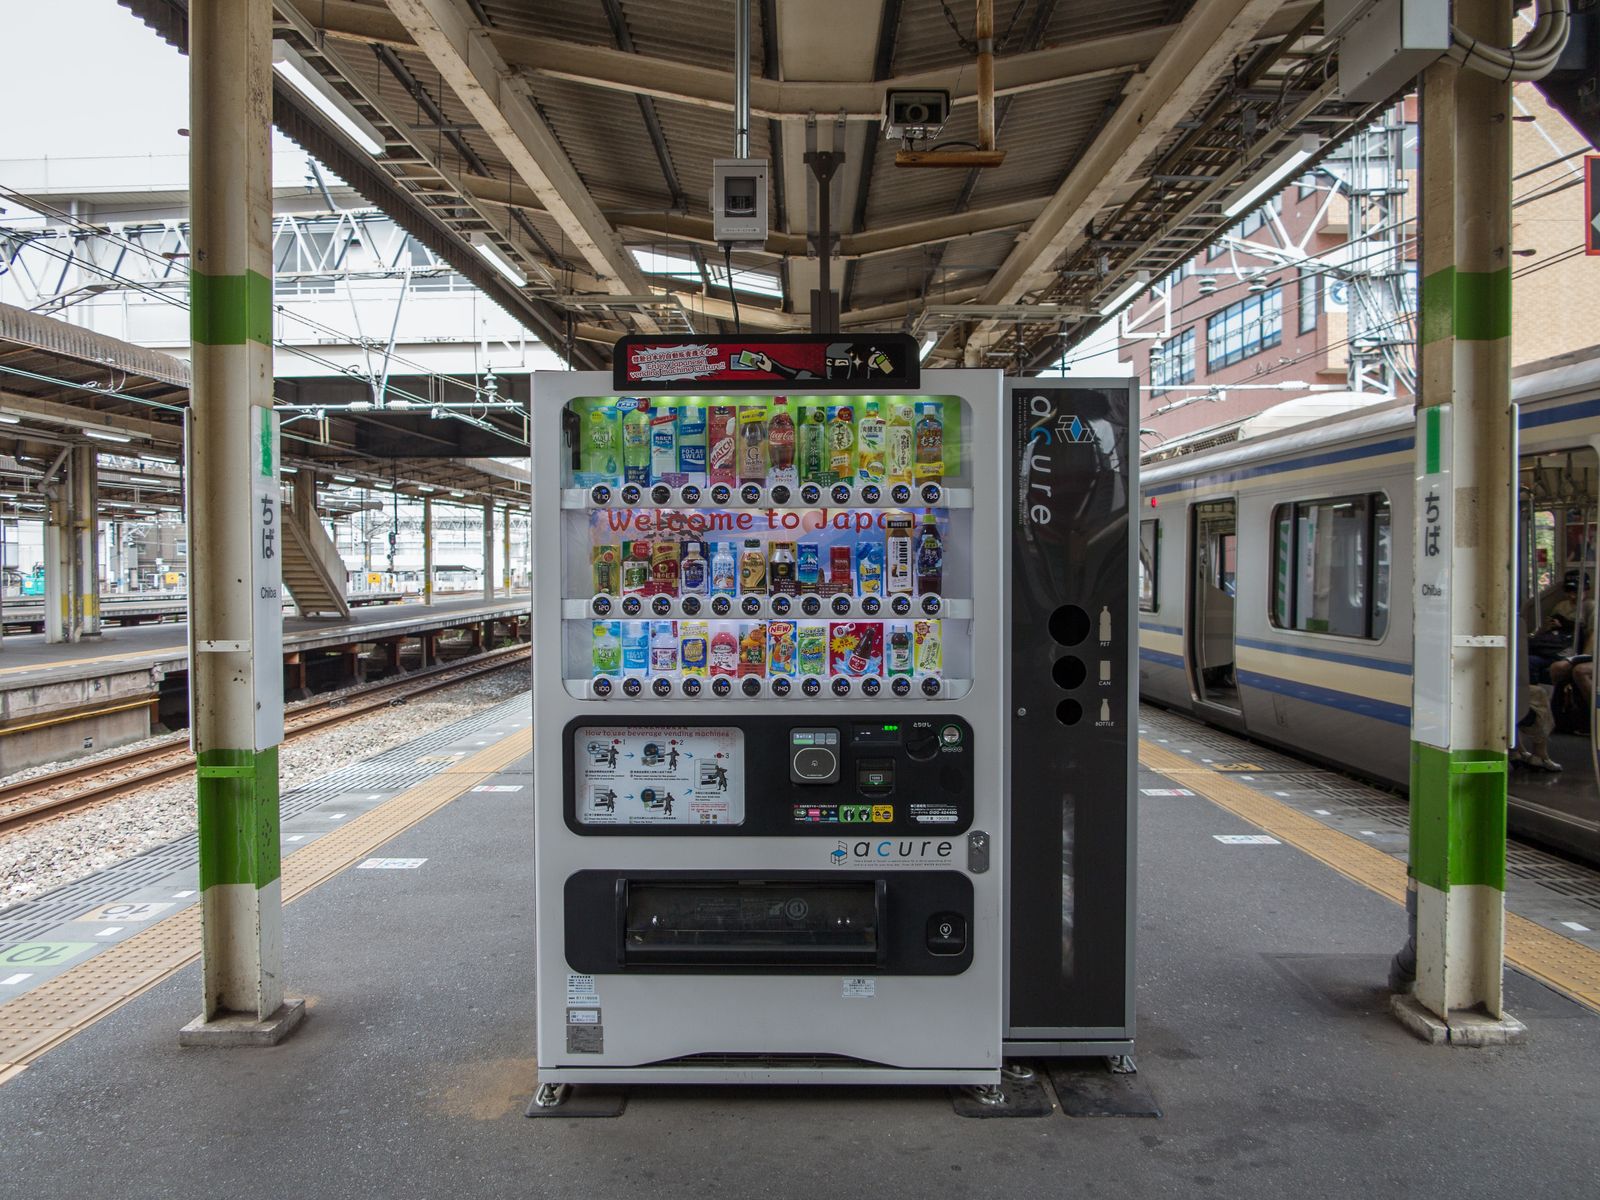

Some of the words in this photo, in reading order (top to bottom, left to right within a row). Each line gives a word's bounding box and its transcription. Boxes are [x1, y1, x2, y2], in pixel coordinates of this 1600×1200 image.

[630, 367, 660, 378] vending
[661, 364, 692, 374] machine
[711, 437, 736, 464] MATCH
[1030, 395, 1052, 525] acure
[261, 494, 275, 559] ちば
[607, 509, 753, 532] Welcome
[765, 508, 799, 530] to
[815, 508, 917, 533] Japa
[1425, 492, 1441, 557] ちば
[261, 587, 276, 599] Chiba
[1422, 584, 1441, 597] Chiba
[770, 624, 790, 634] NEW
[627, 730, 663, 738] beverage
[663, 730, 693, 738] vending
[854, 841, 952, 857] acure
